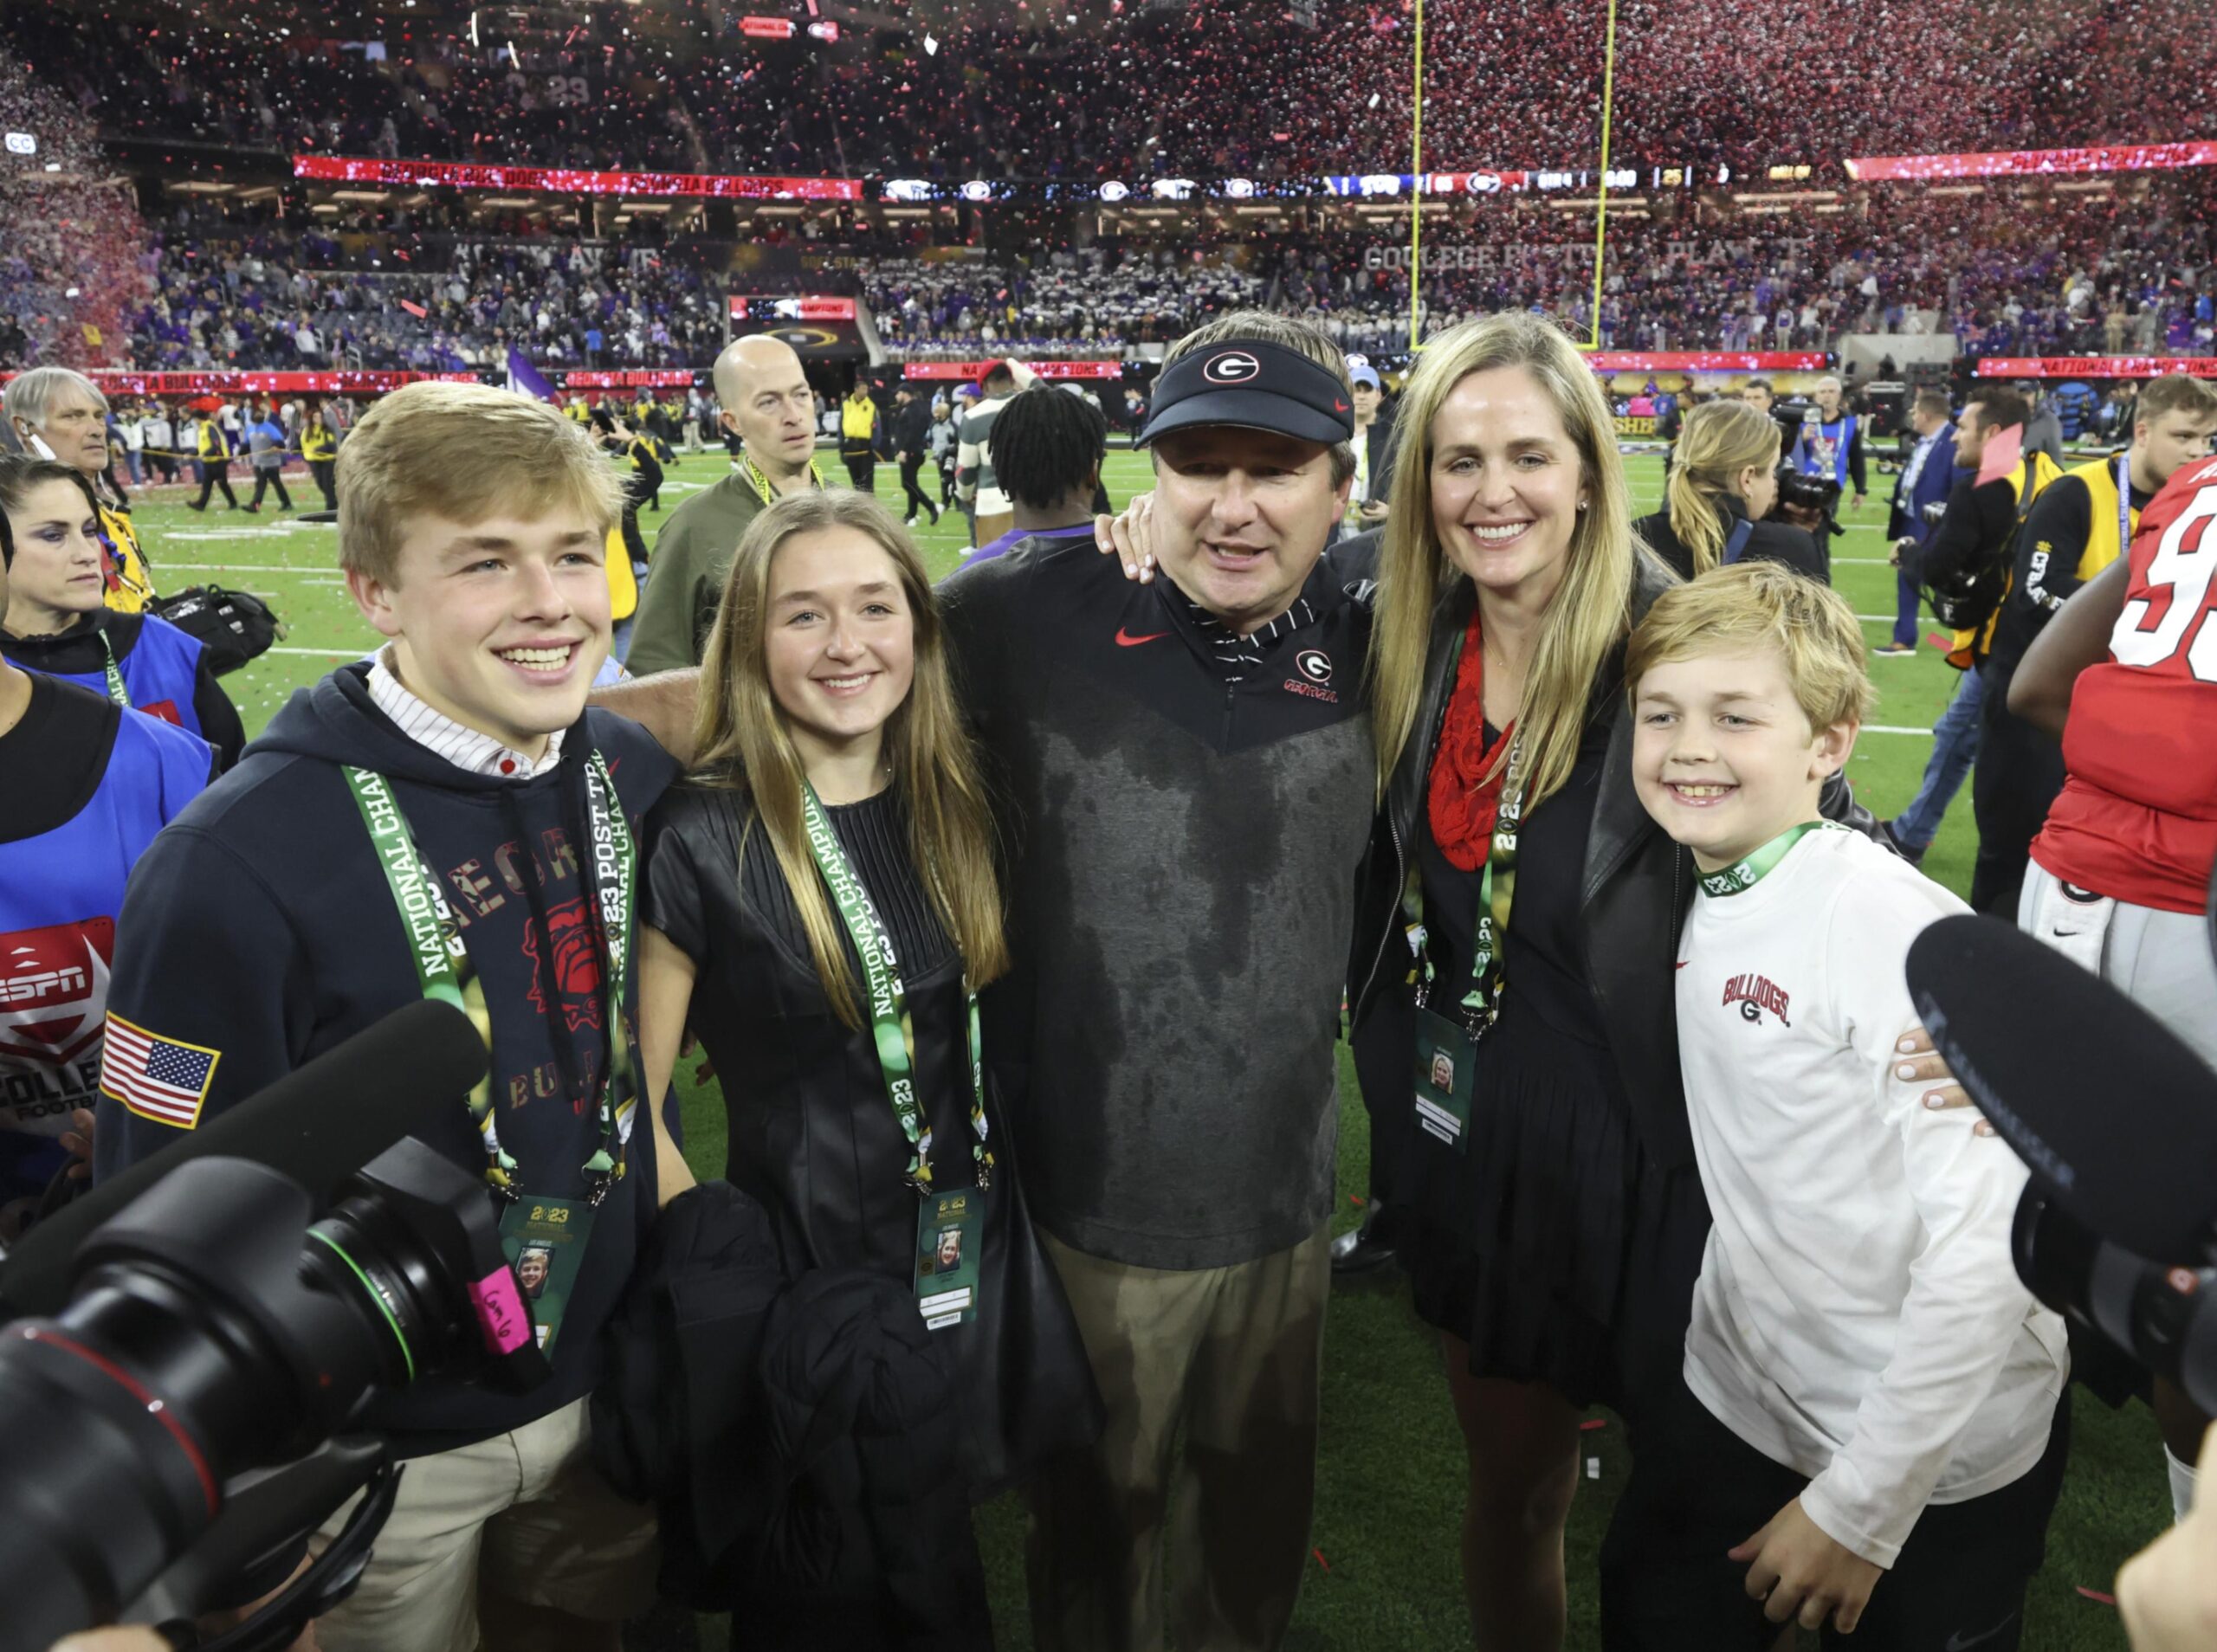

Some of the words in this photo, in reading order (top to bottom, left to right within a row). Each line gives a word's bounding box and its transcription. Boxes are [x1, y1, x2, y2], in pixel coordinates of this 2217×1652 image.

[10, 136, 31, 150] CC
[464, 166, 546, 184] BULDOGS
[1663, 169, 1683, 185] 25
[1031, 363, 1100, 376] HAMPIONS
[1283, 678, 1338, 704] GEORGIA
[591, 804, 619, 881] POST
[384, 836, 449, 978] NATIONAL
[849, 906, 894, 1019] NATIONAL
[1722, 973, 1790, 1024] BULLDOGS
[0, 1060, 98, 1106] OLLE
[530, 1205, 570, 1223] 2023
